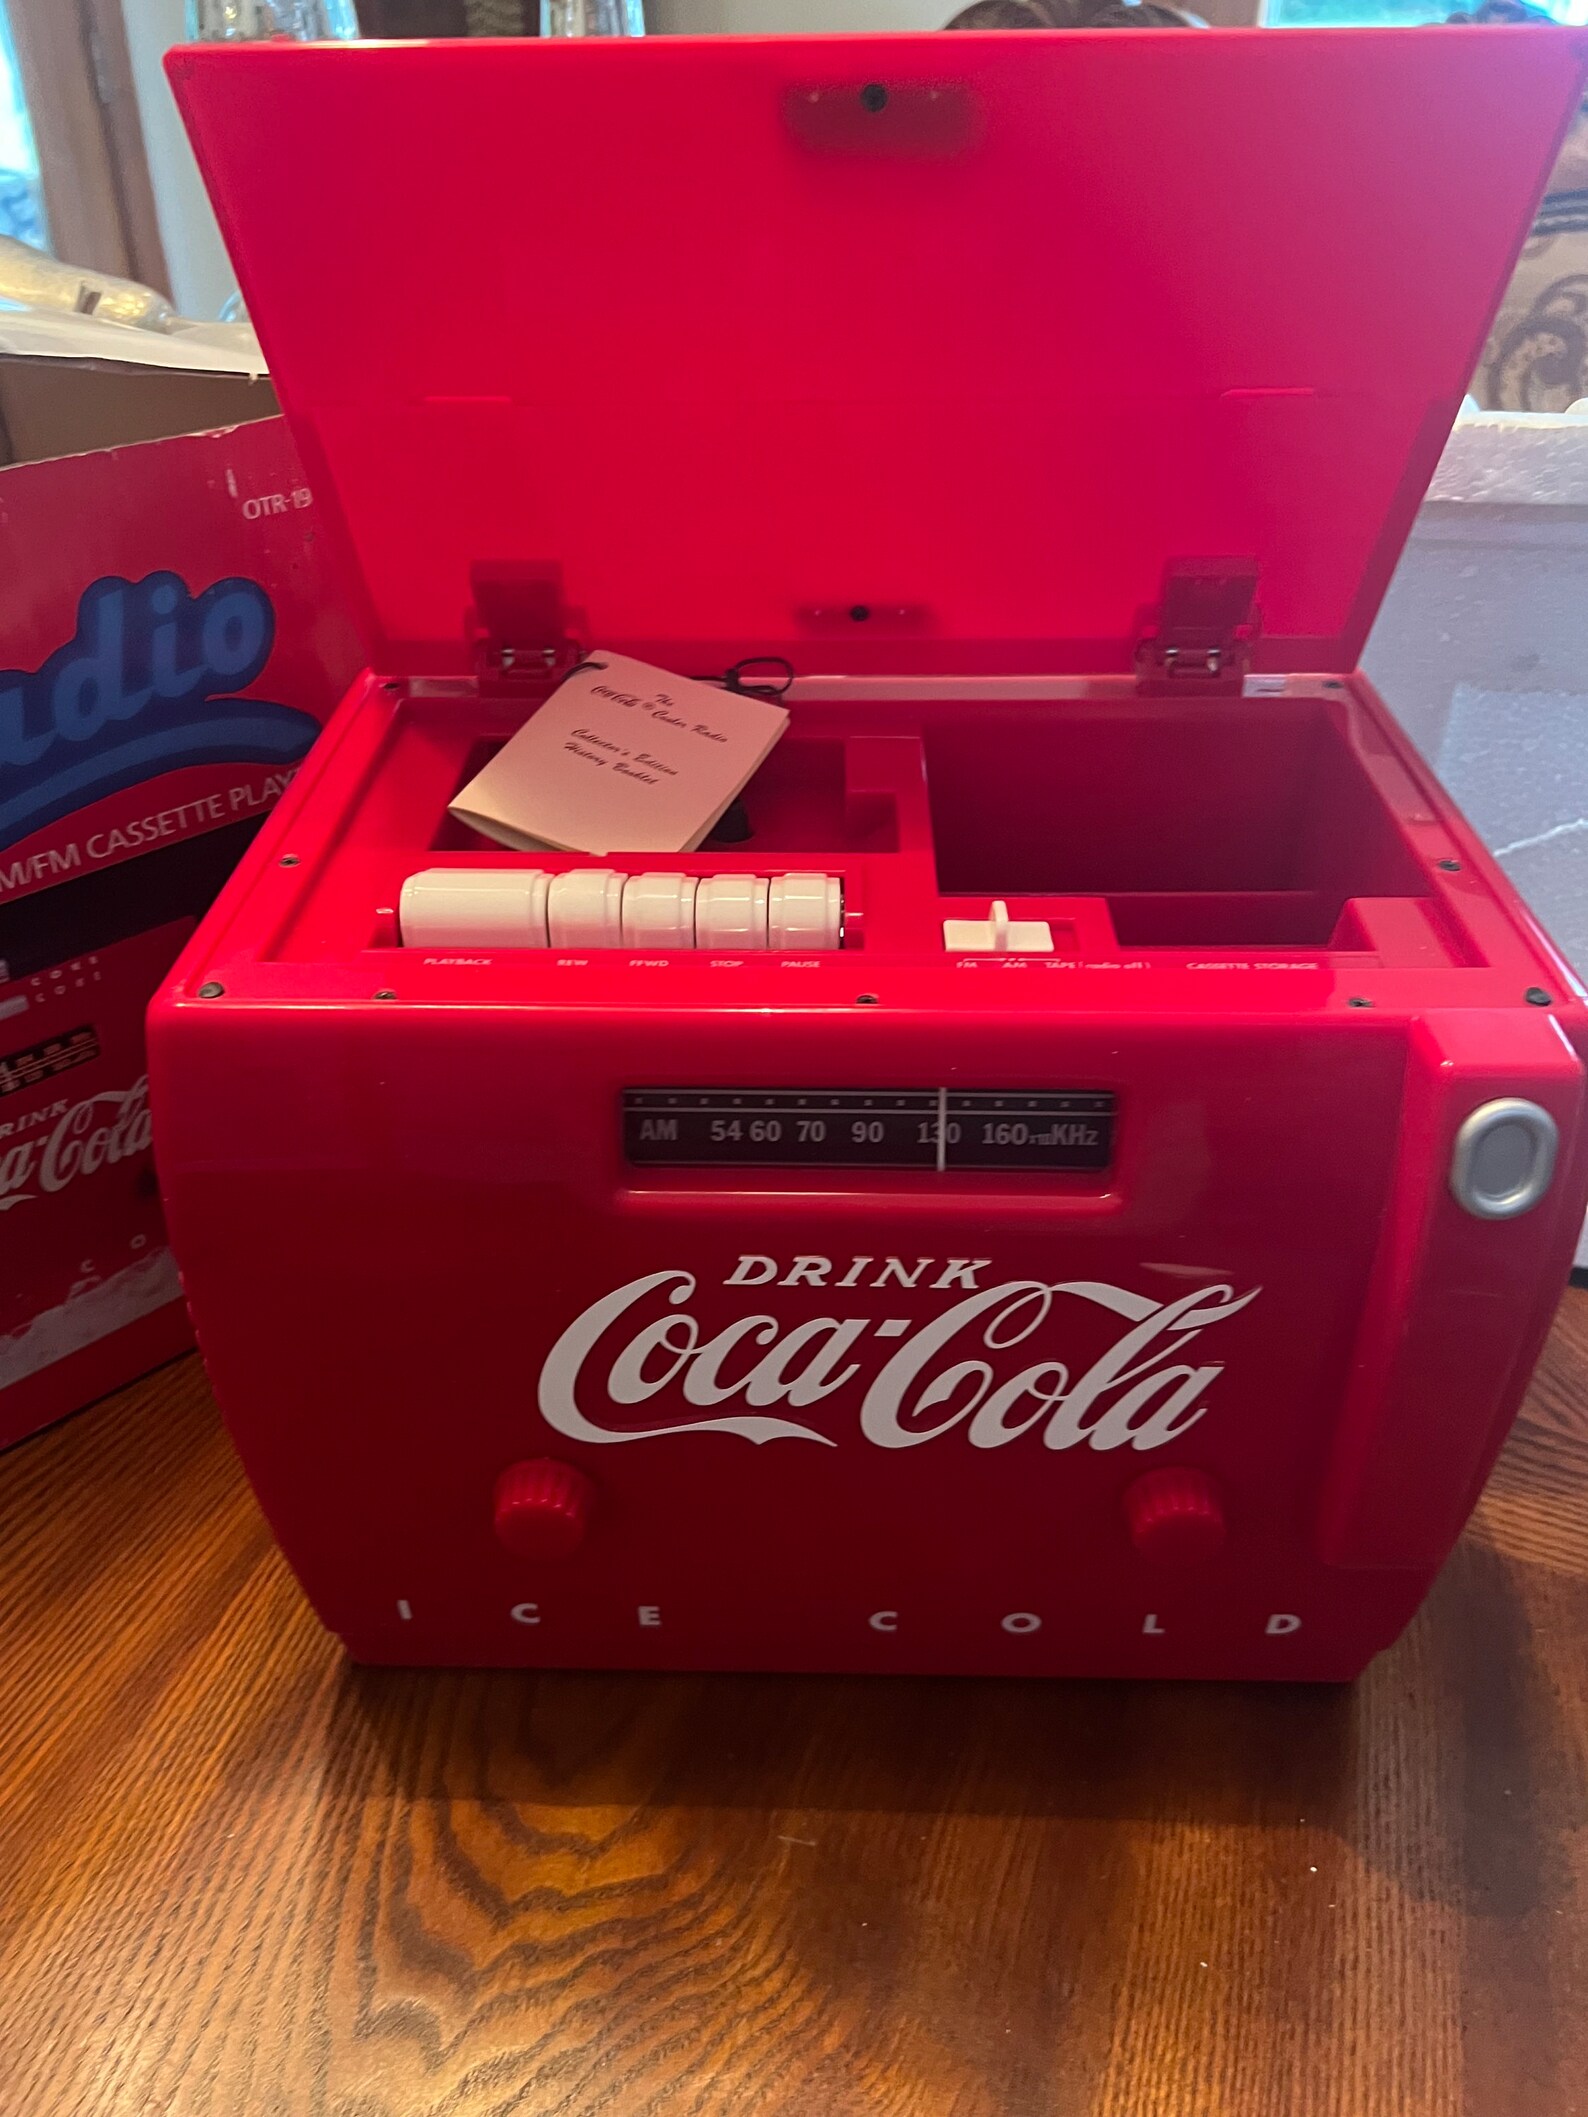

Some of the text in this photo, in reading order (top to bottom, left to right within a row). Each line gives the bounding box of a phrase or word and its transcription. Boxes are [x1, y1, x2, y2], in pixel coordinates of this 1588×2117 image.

[655, 693, 675, 707] The
[690, 724, 728, 743] Radio
[564, 742, 660, 785] History Booklet
[632, 753, 679, 775] Edition
[86, 794, 226, 859] CASSETTE
[230, 766, 299, 811] PLAY
[423, 957, 494, 966] PLAYBACK
[556, 958, 589, 967] REW
[628, 959, 670, 968] FFWD
[709, 959, 744, 968] STOP
[780, 960, 821, 968] PAUSE
[1044, 961, 1076, 969] TAPE
[1185, 962, 1318, 970] CASSETTE STORAGE
[639, 1118, 679, 1141] AM
[710, 1119, 744, 1142] 54
[749, 1120, 782, 1142] 60
[796, 1120, 827, 1142] 70
[851, 1120, 885, 1143] 90
[723, 1254, 994, 1291] DRINK
[538, 1270, 1263, 1451] Coca-Cola
